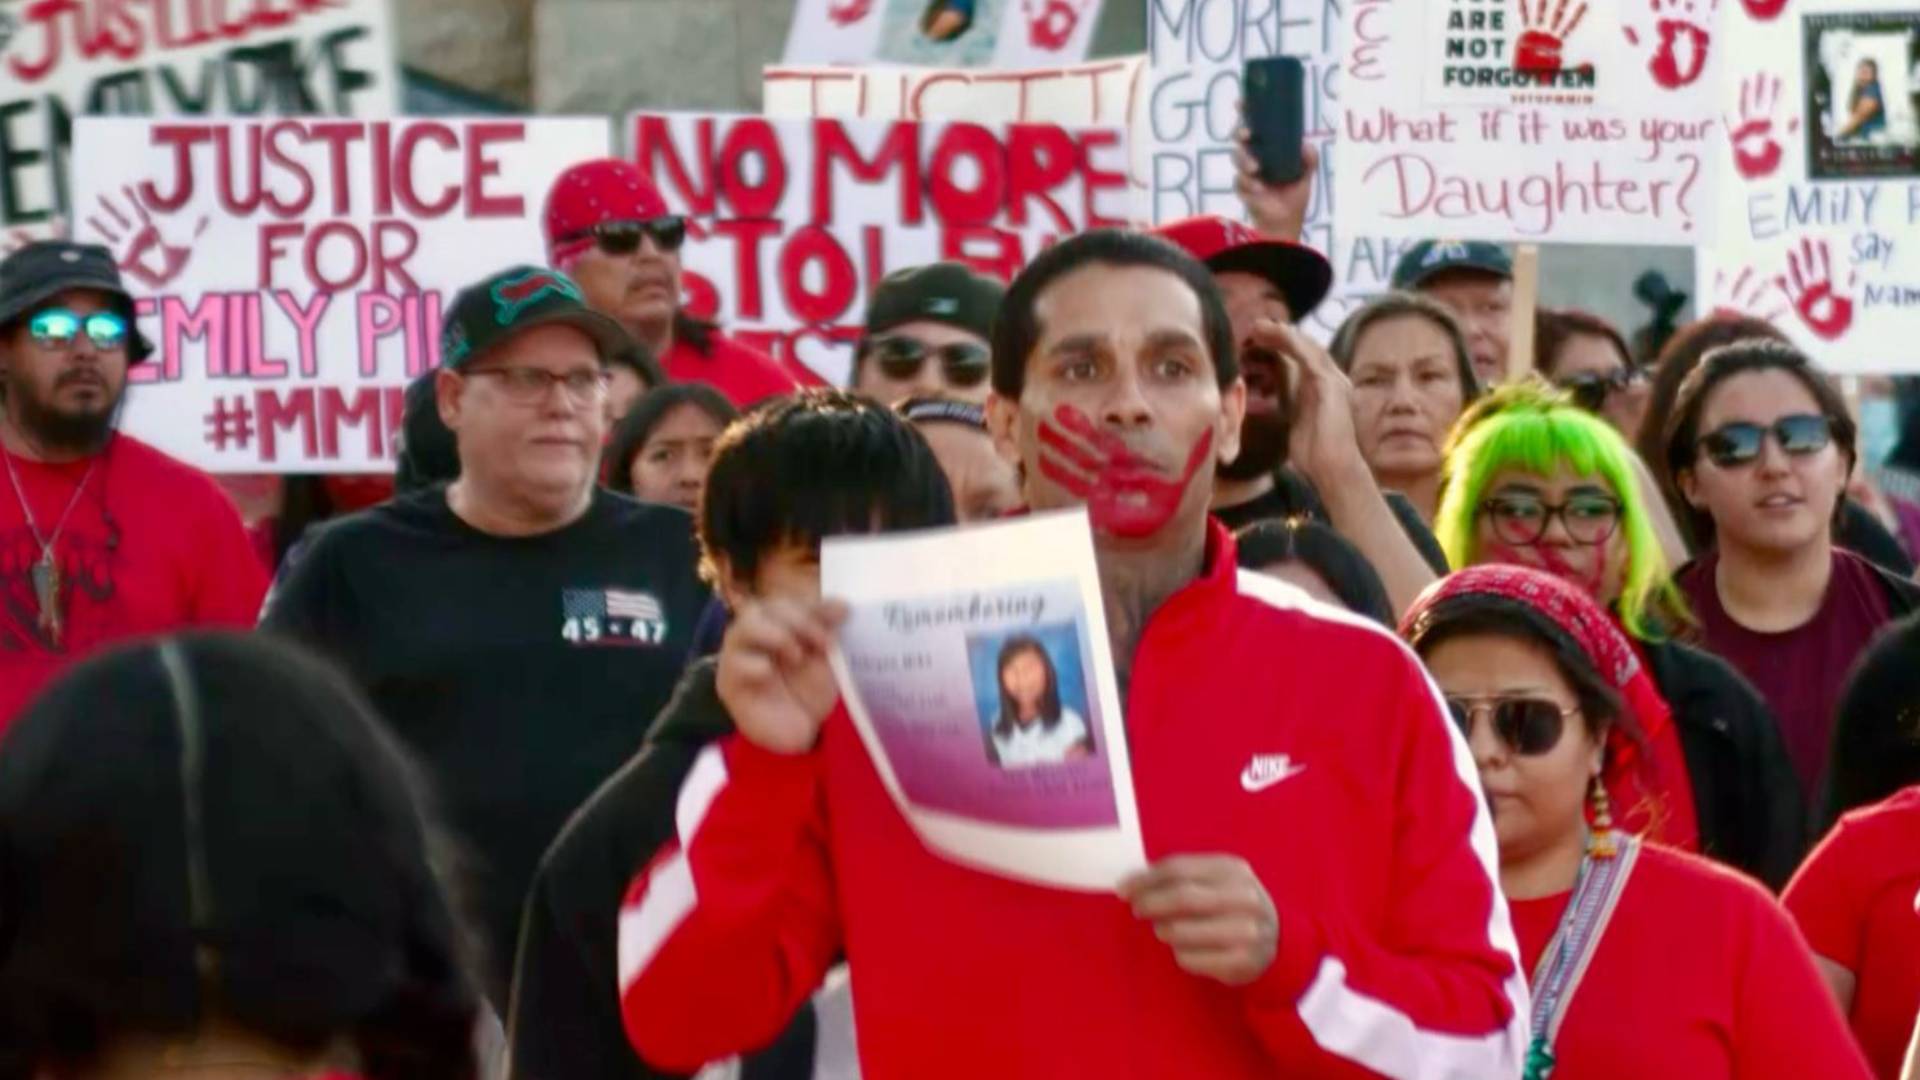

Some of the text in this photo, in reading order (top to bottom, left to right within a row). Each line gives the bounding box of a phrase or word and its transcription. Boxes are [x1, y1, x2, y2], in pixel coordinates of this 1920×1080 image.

[1447, 10, 1504, 30] ARE
[1446, 38, 1505, 58] NOT
[1443, 65, 1595, 87] FORGOTTEN
[1346, 108, 1713, 162] What if it was your
[138, 120, 525, 218] JUSTICE
[637, 114, 1129, 232] NO MORE
[1363, 154, 1702, 234] Daughter?
[256, 220, 420, 292] FOR
[126, 288, 334, 384] EMILY
[562, 617, 668, 645] 45 47
[1250, 753, 1291, 780] NIKE
